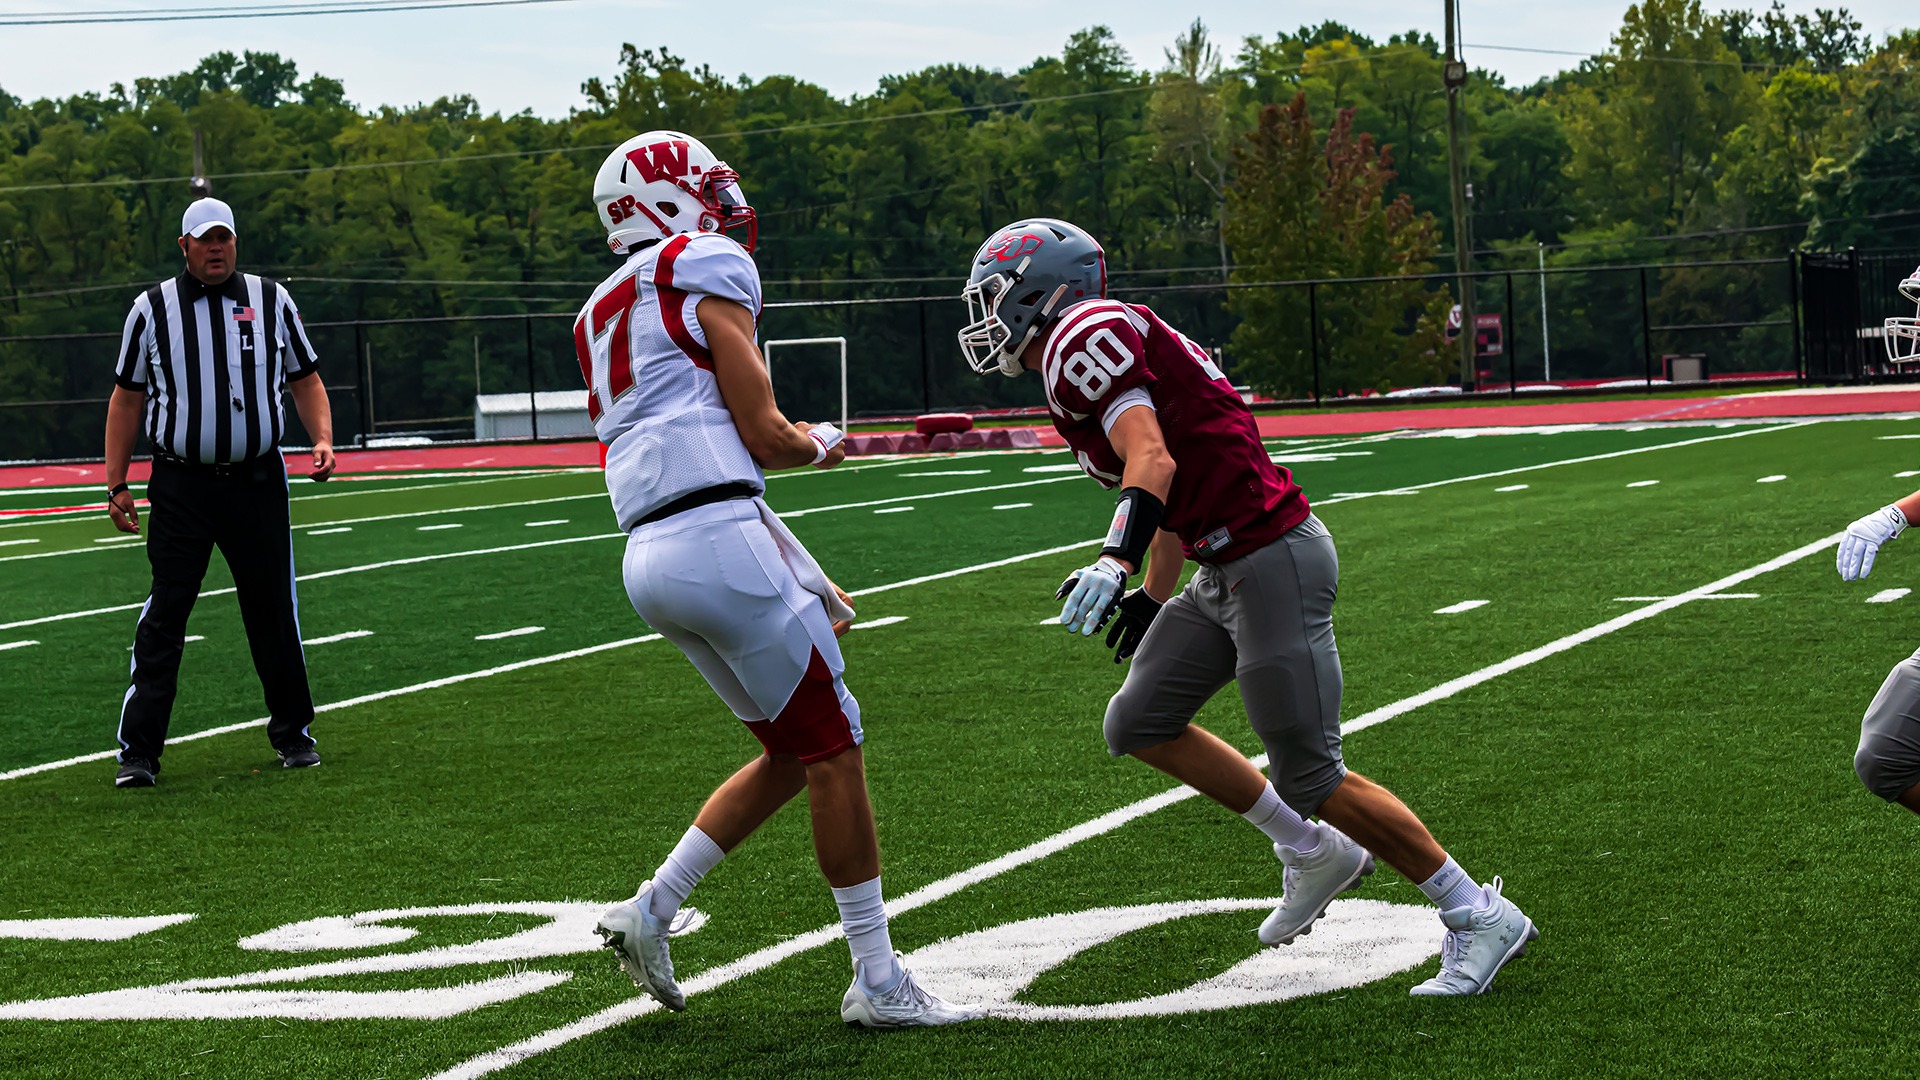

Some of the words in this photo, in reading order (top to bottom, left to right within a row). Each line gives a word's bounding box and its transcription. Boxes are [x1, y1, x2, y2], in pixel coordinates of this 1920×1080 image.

[606, 194, 636, 225] SP
[242, 334, 254, 351] L
[573, 270, 642, 426] 17
[1063, 328, 1135, 401] 80
